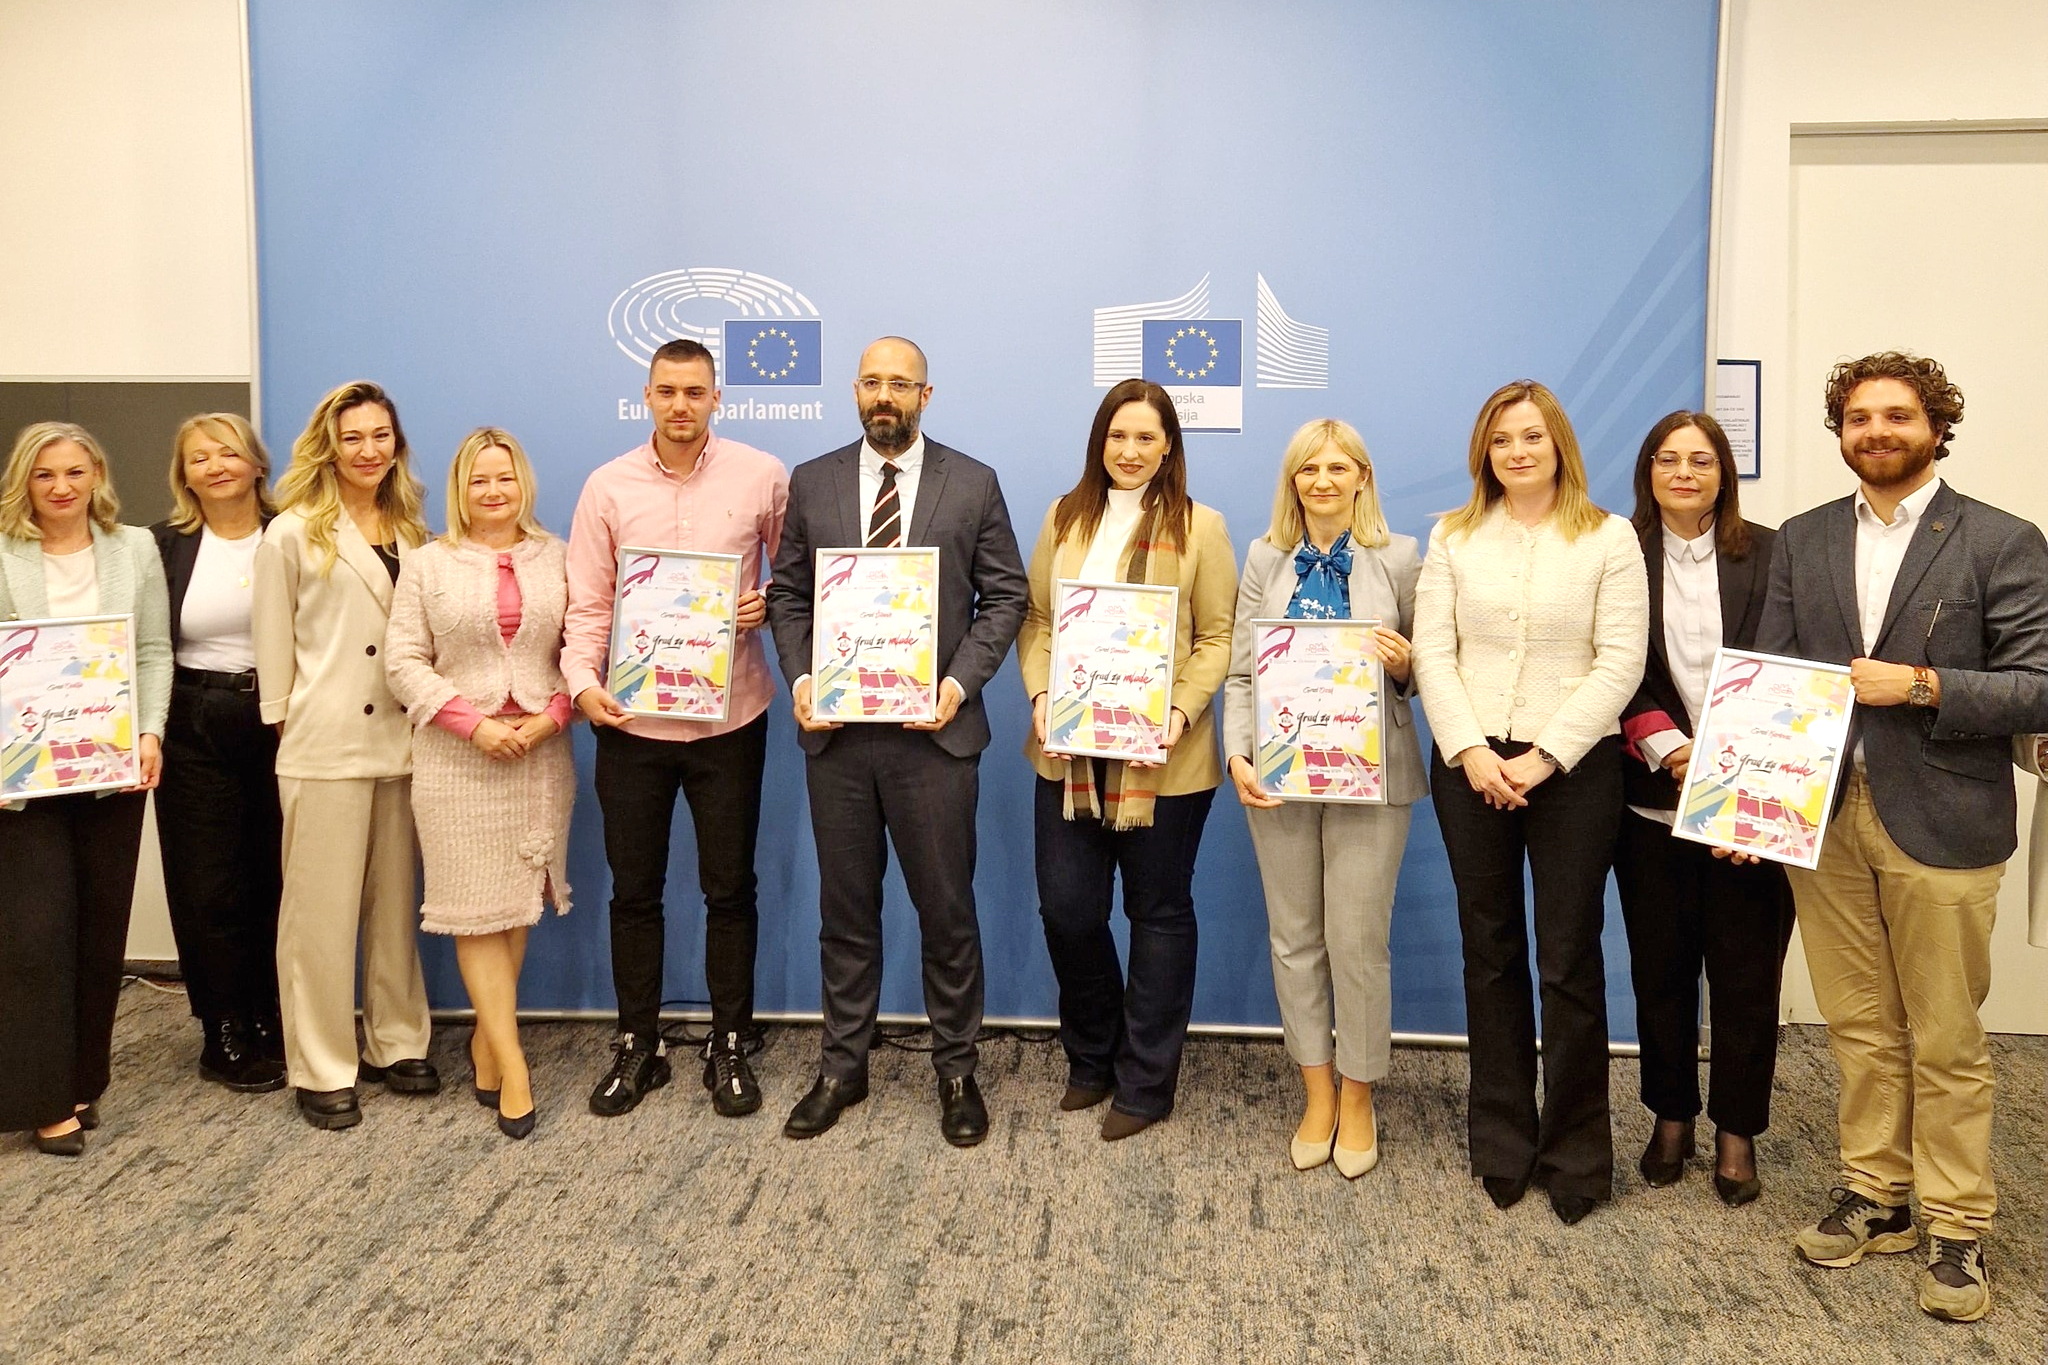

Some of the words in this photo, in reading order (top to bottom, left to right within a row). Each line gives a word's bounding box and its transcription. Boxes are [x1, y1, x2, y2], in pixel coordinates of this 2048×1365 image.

[1170, 392, 1205, 406] opska
[714, 398, 823, 425] parlament
[1177, 409, 1199, 423] sija
[1090, 670, 1112, 690] grad
[1123, 668, 1154, 684] mlade
[1297, 710, 1321, 732] grad
[1333, 706, 1366, 724] mlade
